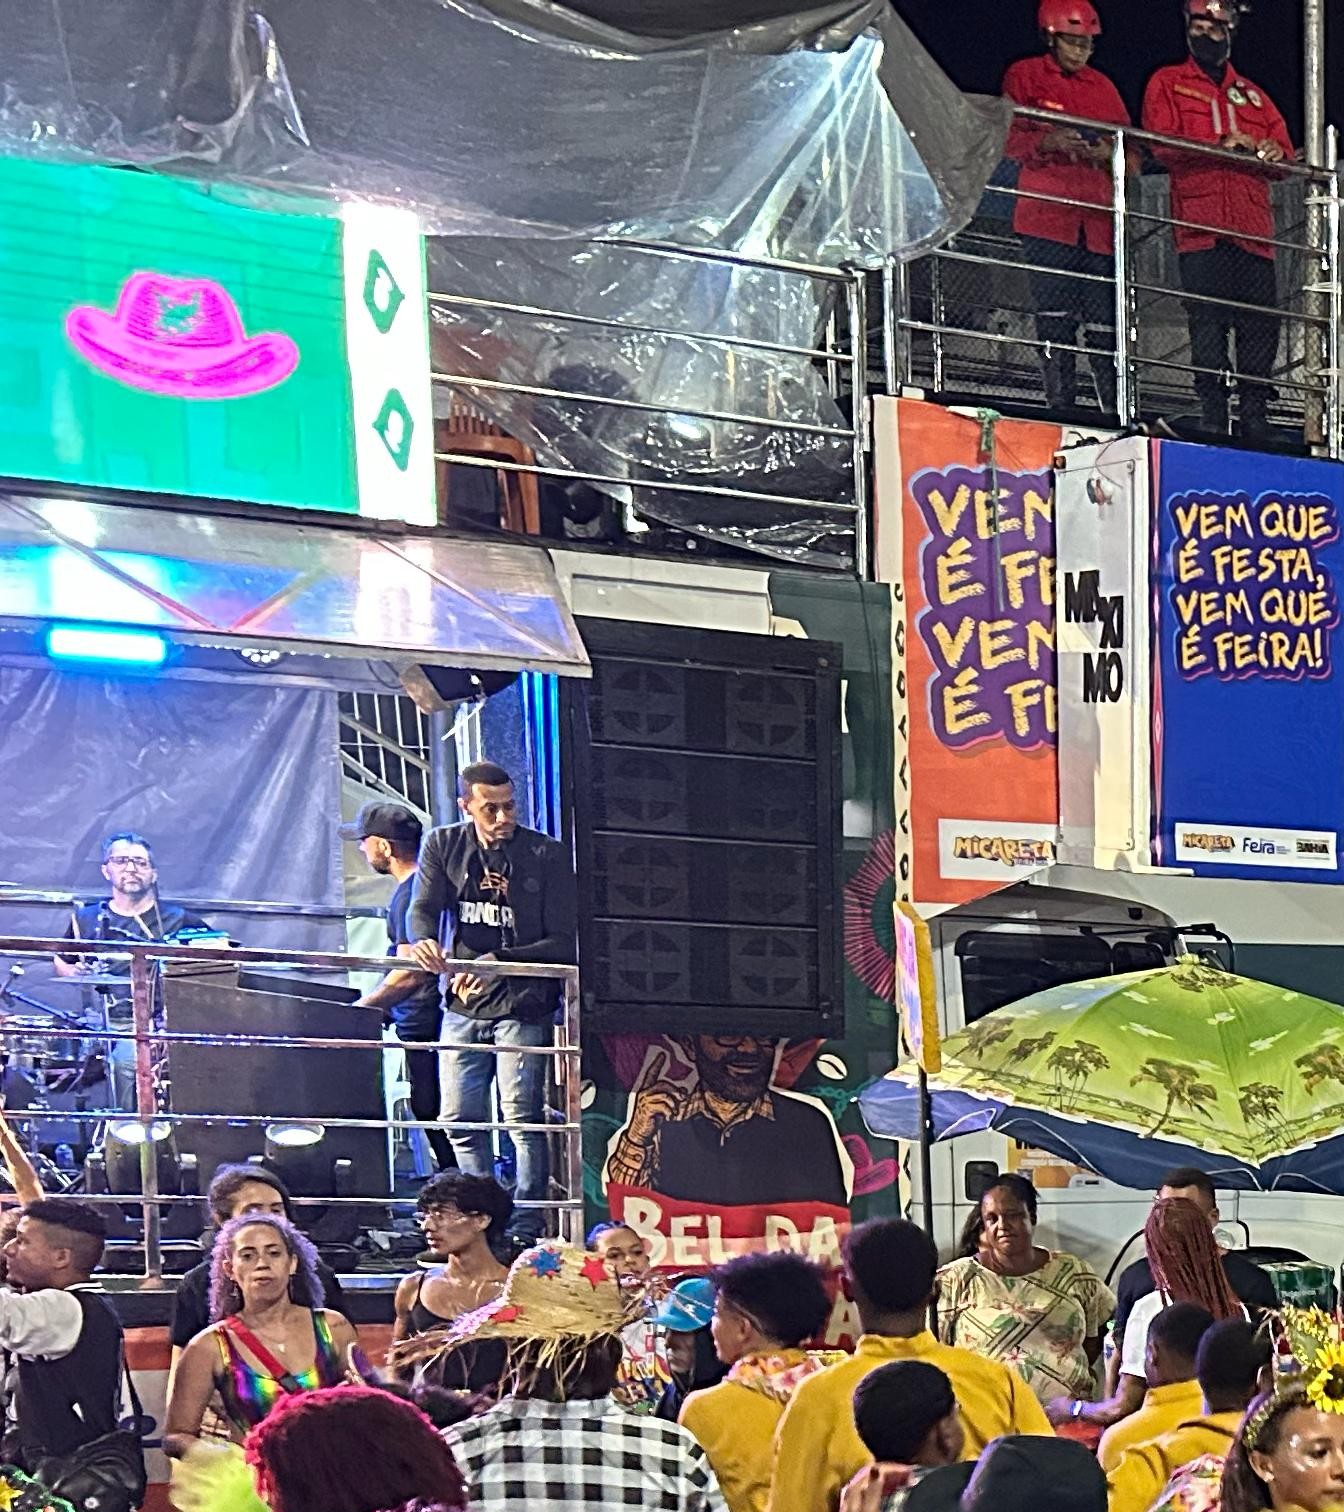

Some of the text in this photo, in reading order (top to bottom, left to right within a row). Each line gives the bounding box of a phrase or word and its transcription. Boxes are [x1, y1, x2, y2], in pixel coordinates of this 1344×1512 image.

[1175, 502, 1333, 541] VEM QUE
[937, 537, 987, 605] É
[1178, 537, 1326, 590] É FESTA,
[1175, 587, 1333, 627] VEM QUE
[1181, 624, 1208, 670] É
[942, 666, 992, 735] É
[623, 1196, 727, 1268] BEL
